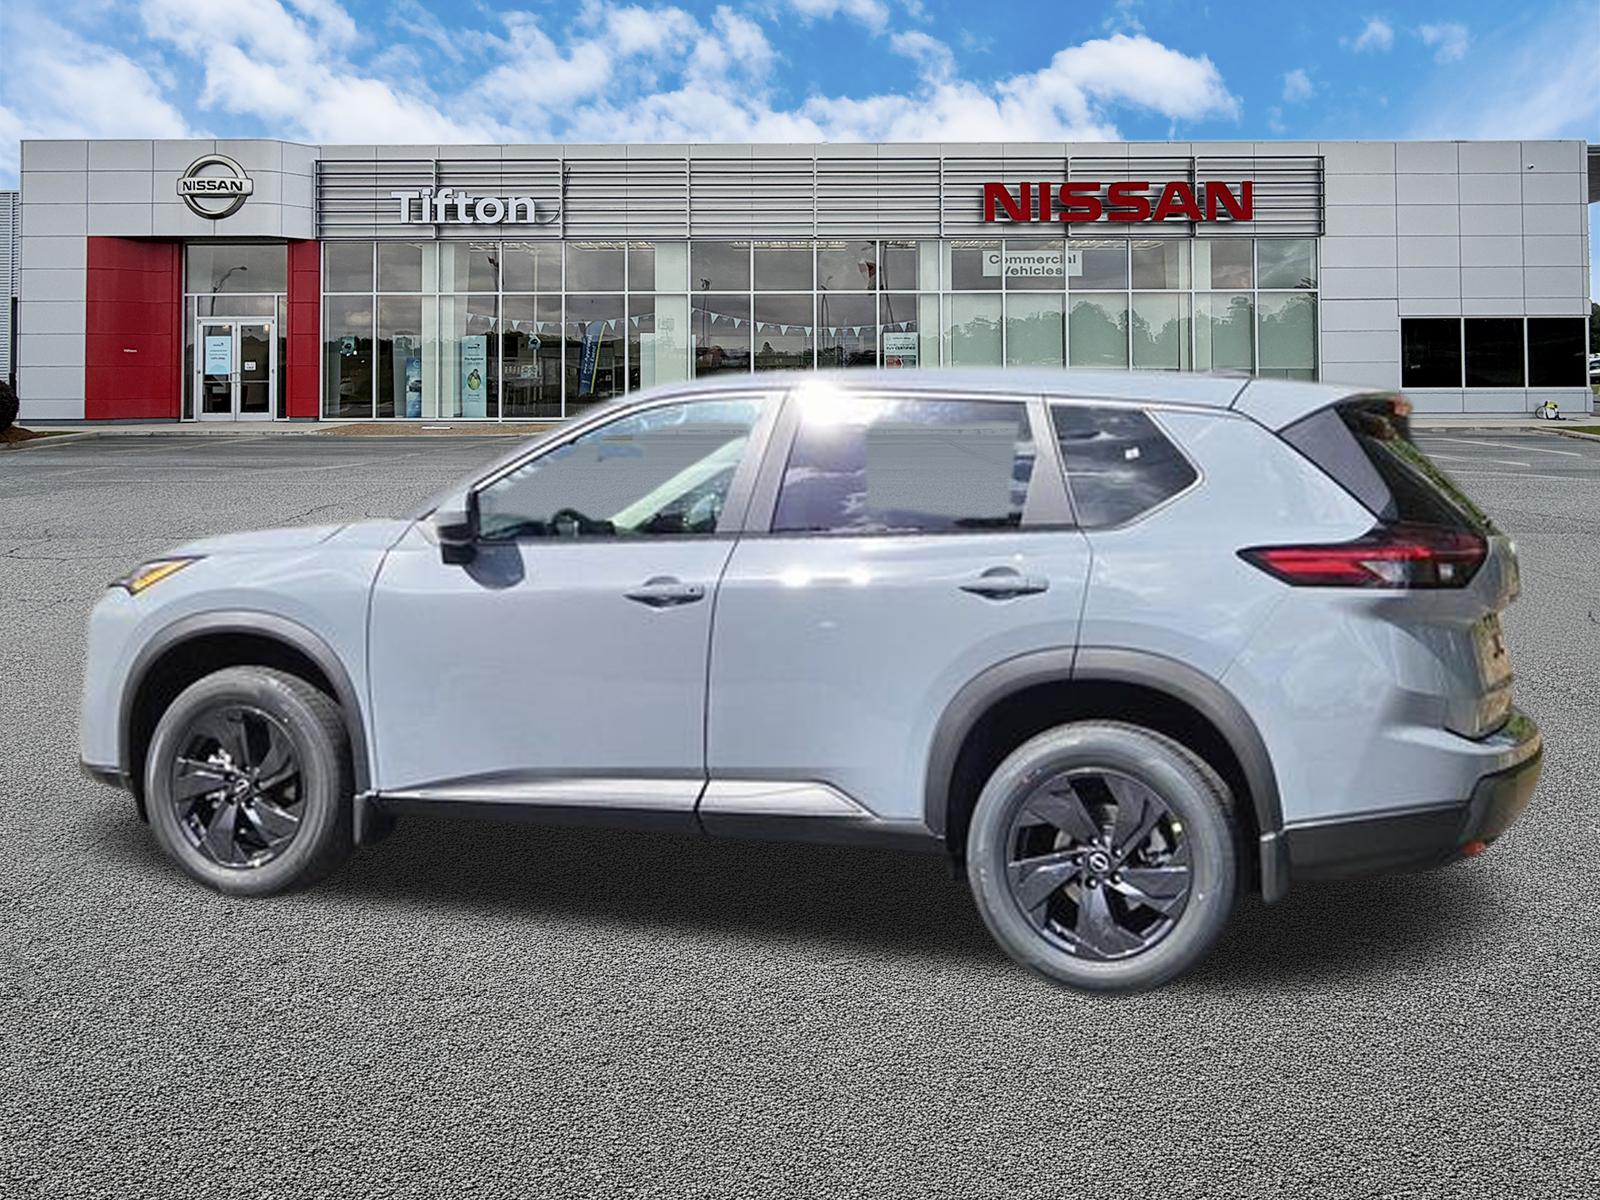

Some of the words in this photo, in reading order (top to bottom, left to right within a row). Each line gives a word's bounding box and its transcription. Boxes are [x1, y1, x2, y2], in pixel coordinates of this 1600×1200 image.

[182, 180, 243, 191] NISSAN
[984, 181, 1253, 222] NISSAN
[390, 188, 536, 224] Tifton
